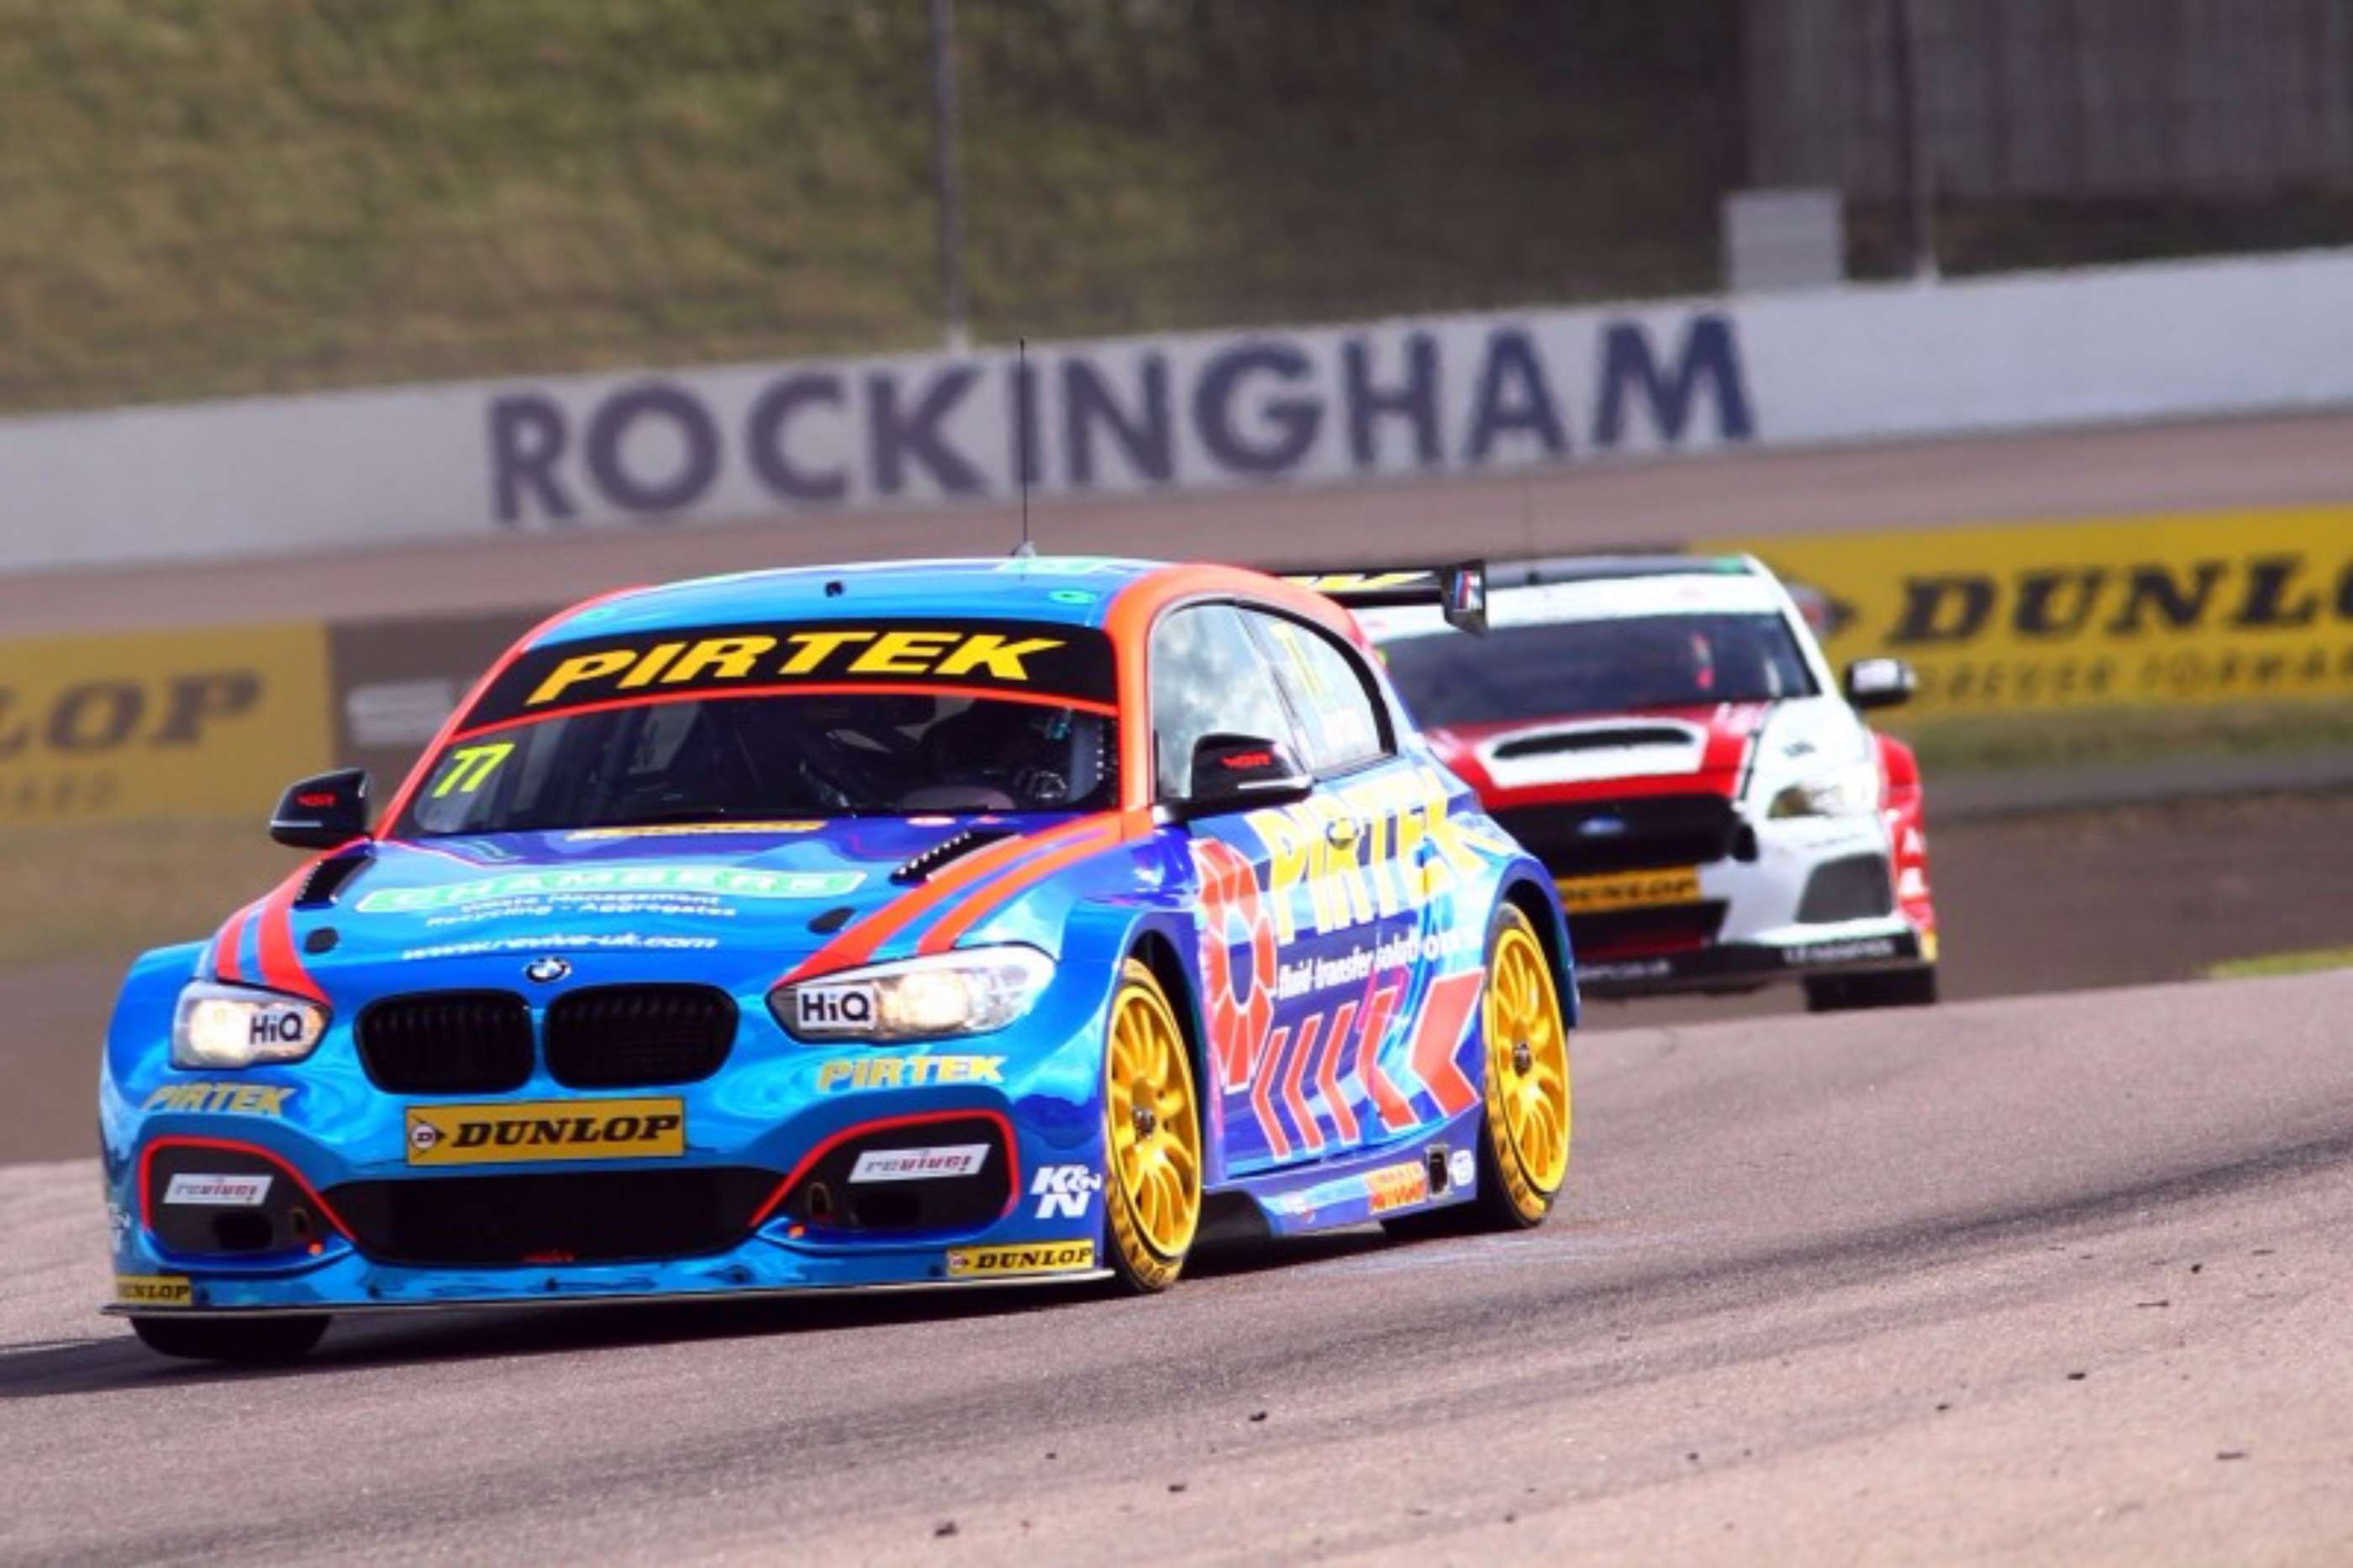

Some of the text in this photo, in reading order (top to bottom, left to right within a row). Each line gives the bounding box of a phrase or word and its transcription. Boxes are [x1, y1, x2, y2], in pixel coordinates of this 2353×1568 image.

[487, 313, 1756, 523] ROCKINGHAM
[1885, 553, 2353, 645] DUNL
[524, 631, 1066, 707] PIRTEK
[433, 743, 515, 798] 77
[1245, 766, 1515, 945] PIRTEK
[800, 992, 871, 1023] HiQ
[249, 1012, 303, 1045] HiQ
[817, 1054, 1007, 1092] PIRTEK
[140, 1082, 297, 1115] PIRTEK
[450, 1114, 681, 1149] DUNLOP
[975, 1247, 1092, 1269] DUNLOP
